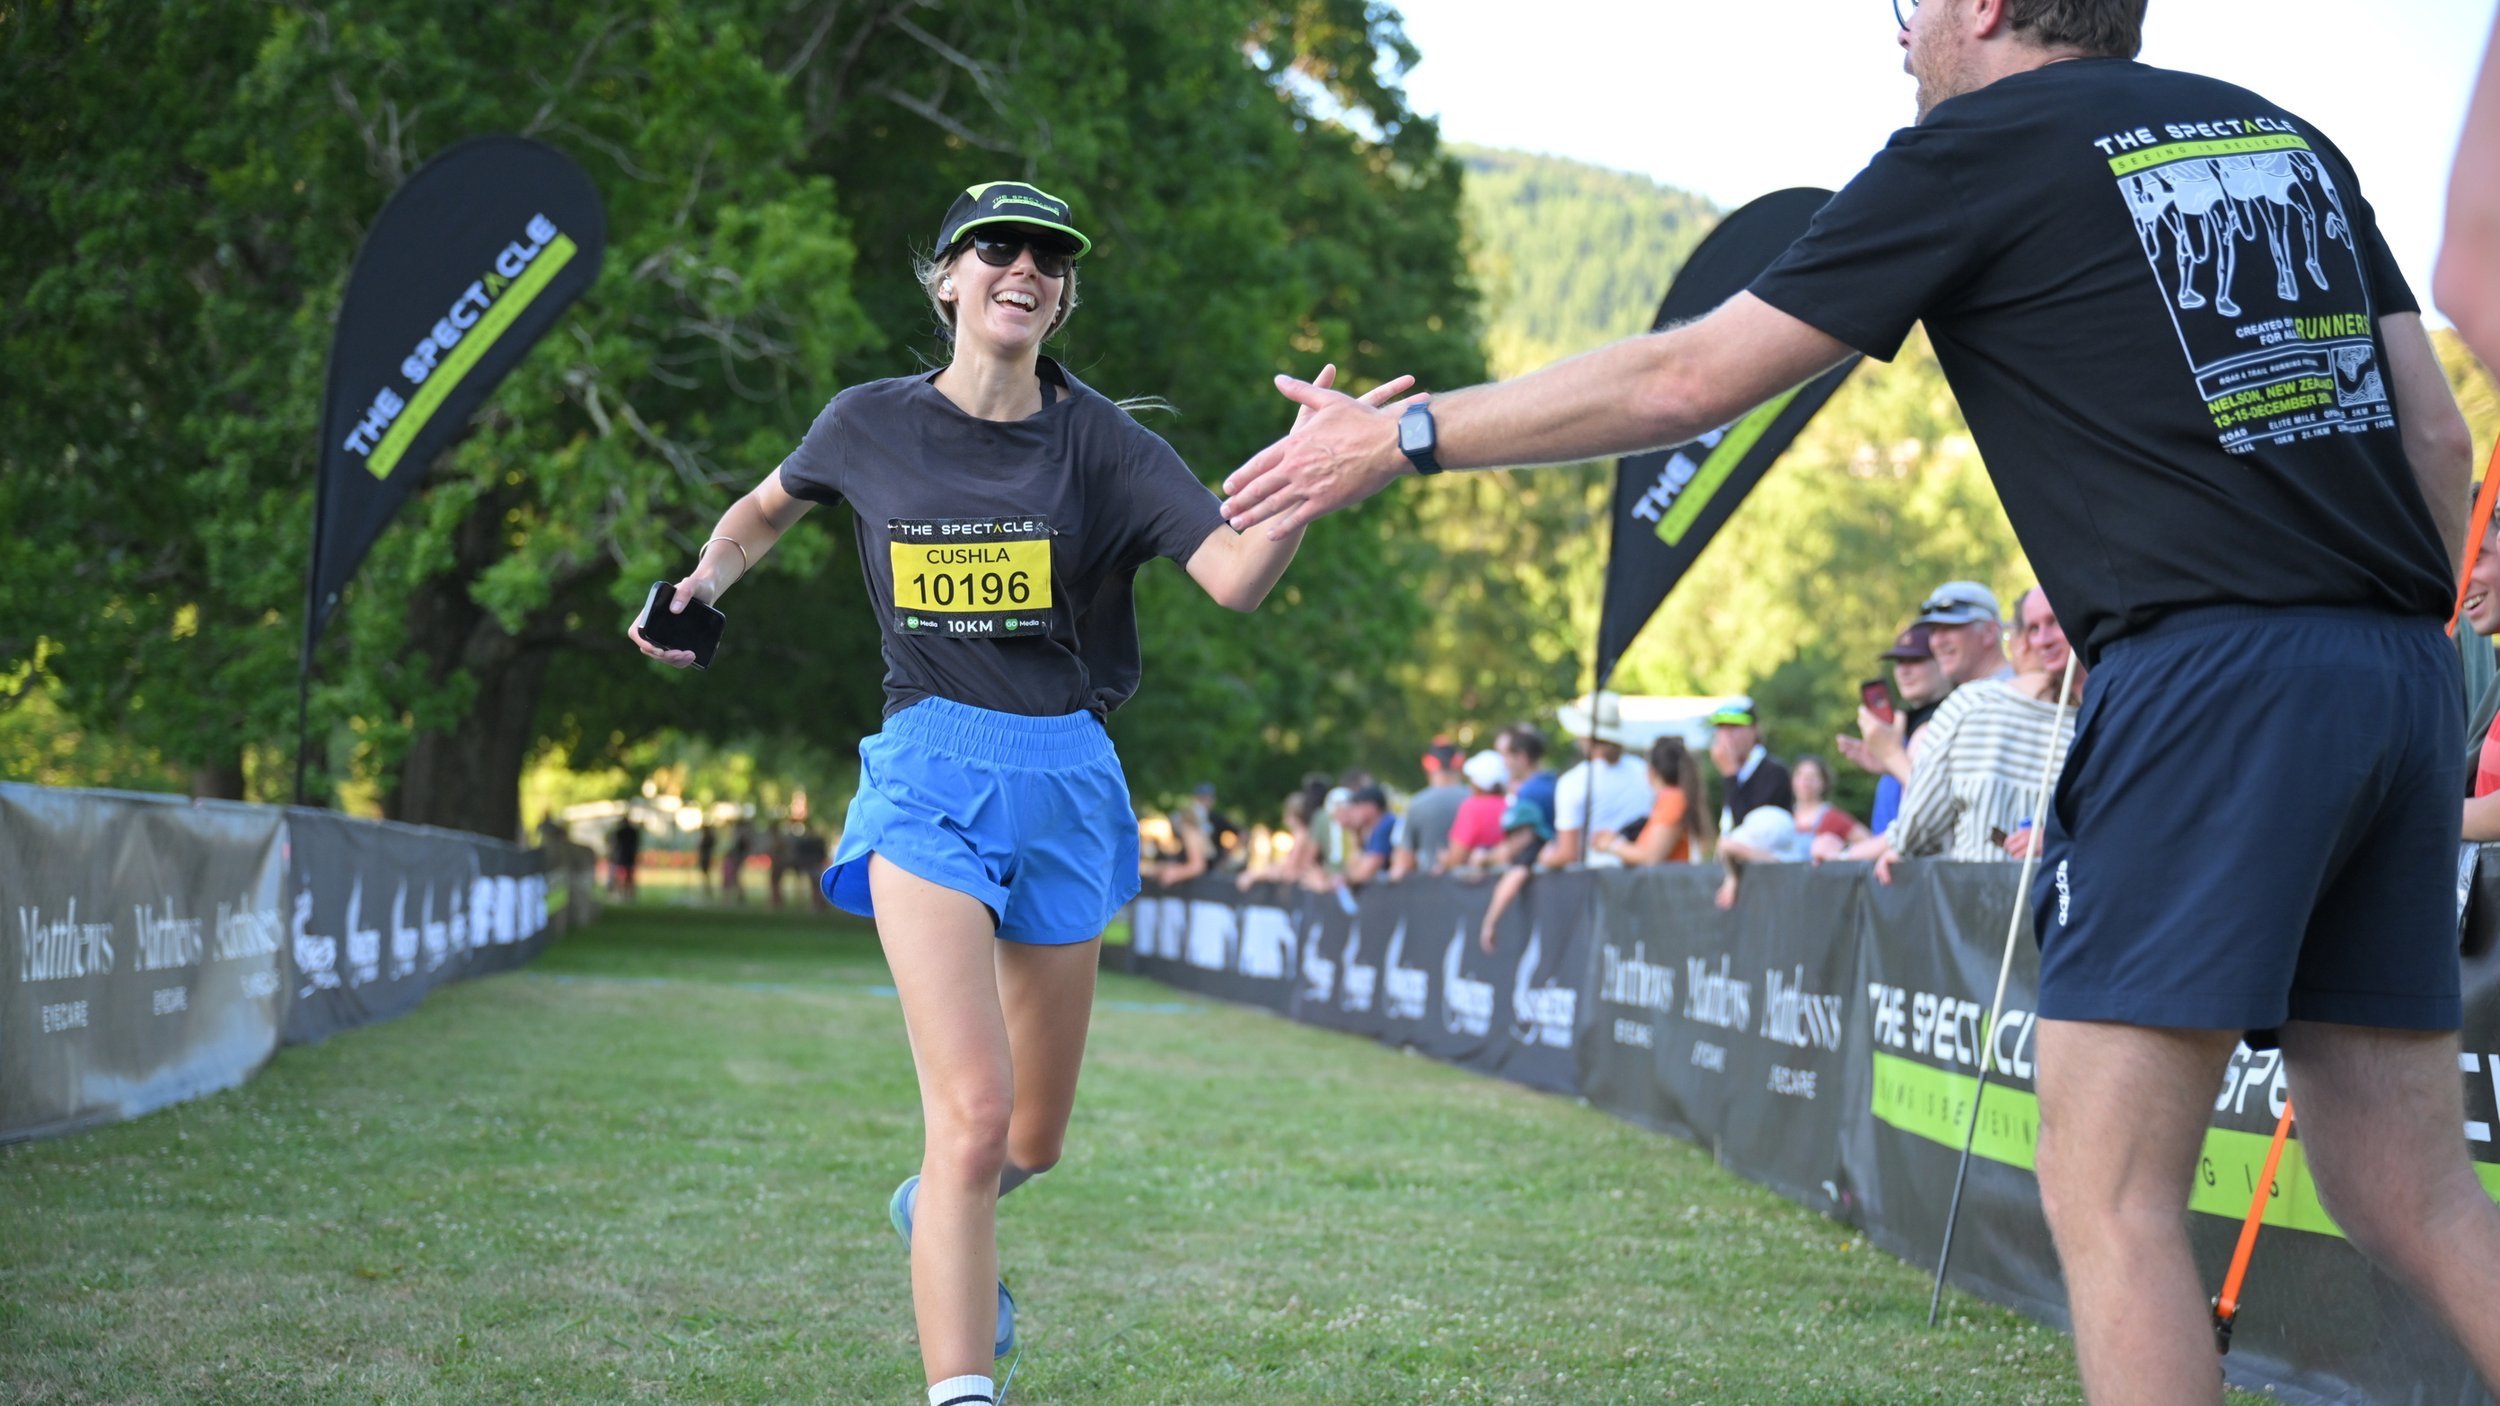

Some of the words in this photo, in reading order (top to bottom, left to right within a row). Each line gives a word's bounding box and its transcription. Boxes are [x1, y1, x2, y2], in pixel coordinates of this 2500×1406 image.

[2094, 127, 2157, 155] THE
[2164, 118, 2298, 138] SPECTACLE
[343, 386, 405, 456] THE
[400, 212, 557, 384] SPECTACLE
[2235, 320, 2284, 338] CREATED
[2259, 331, 2283, 345] FOR
[2208, 391, 2264, 414] NELSON,
[2266, 383, 2297, 398] NEW
[902, 525, 932, 536] THE
[941, 521, 1034, 535] SPECTACLE
[926, 547, 1011, 564] CUSHLA
[913, 571, 1030, 606] 10196
[947, 620, 993, 633] 10KM
